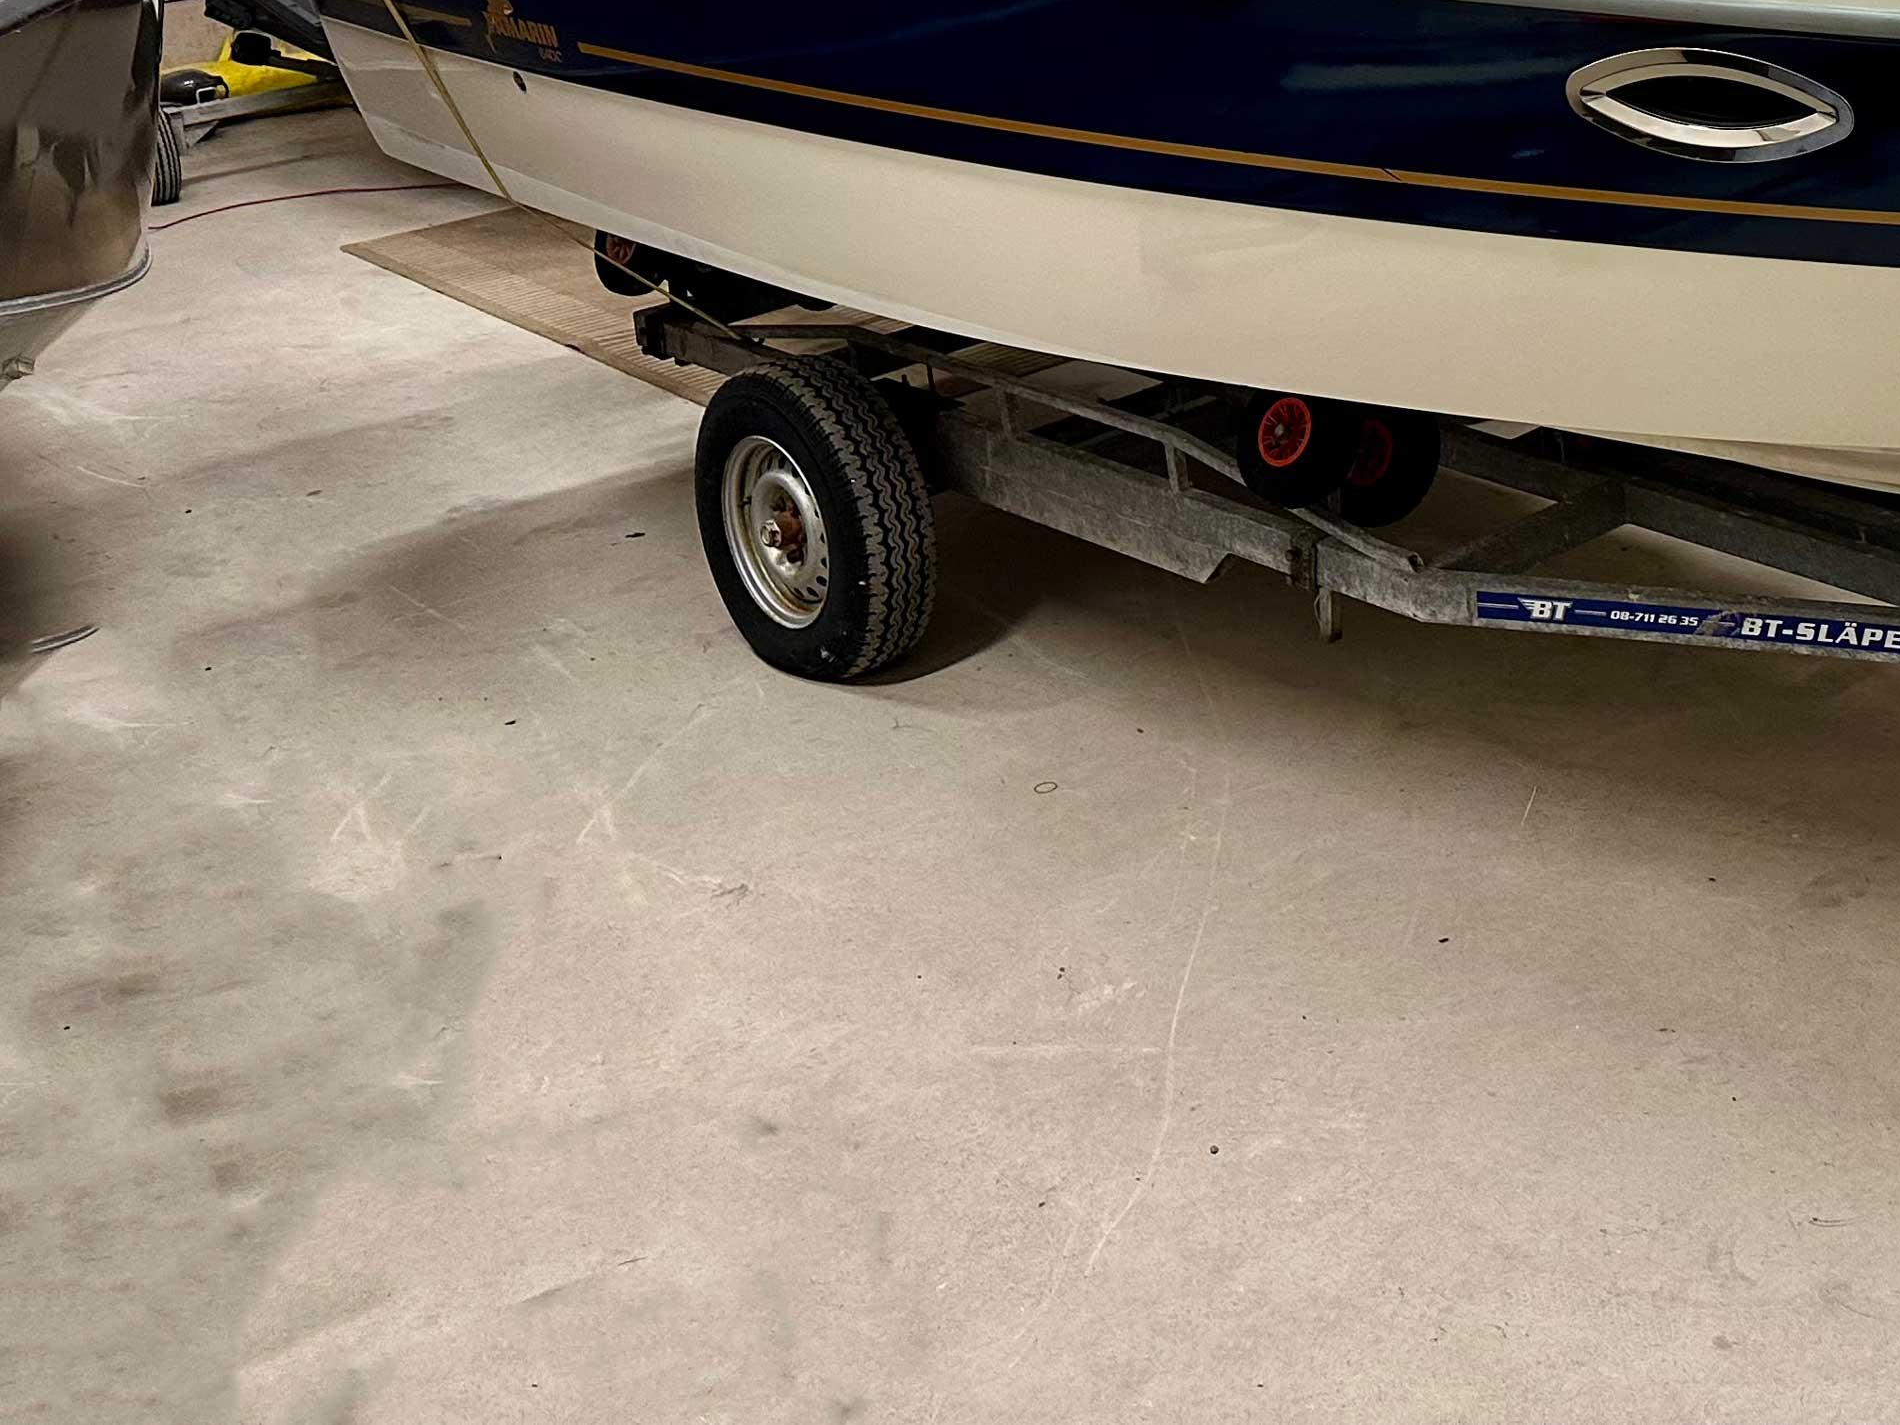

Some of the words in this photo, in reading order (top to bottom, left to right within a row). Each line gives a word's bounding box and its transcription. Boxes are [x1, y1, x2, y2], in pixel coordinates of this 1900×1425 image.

[1522, 598, 1574, 622] BT
[1610, 610, 1655, 623] 08-711
[1658, 614, 1678, 625] 26
[1679, 616, 1700, 627] 35
